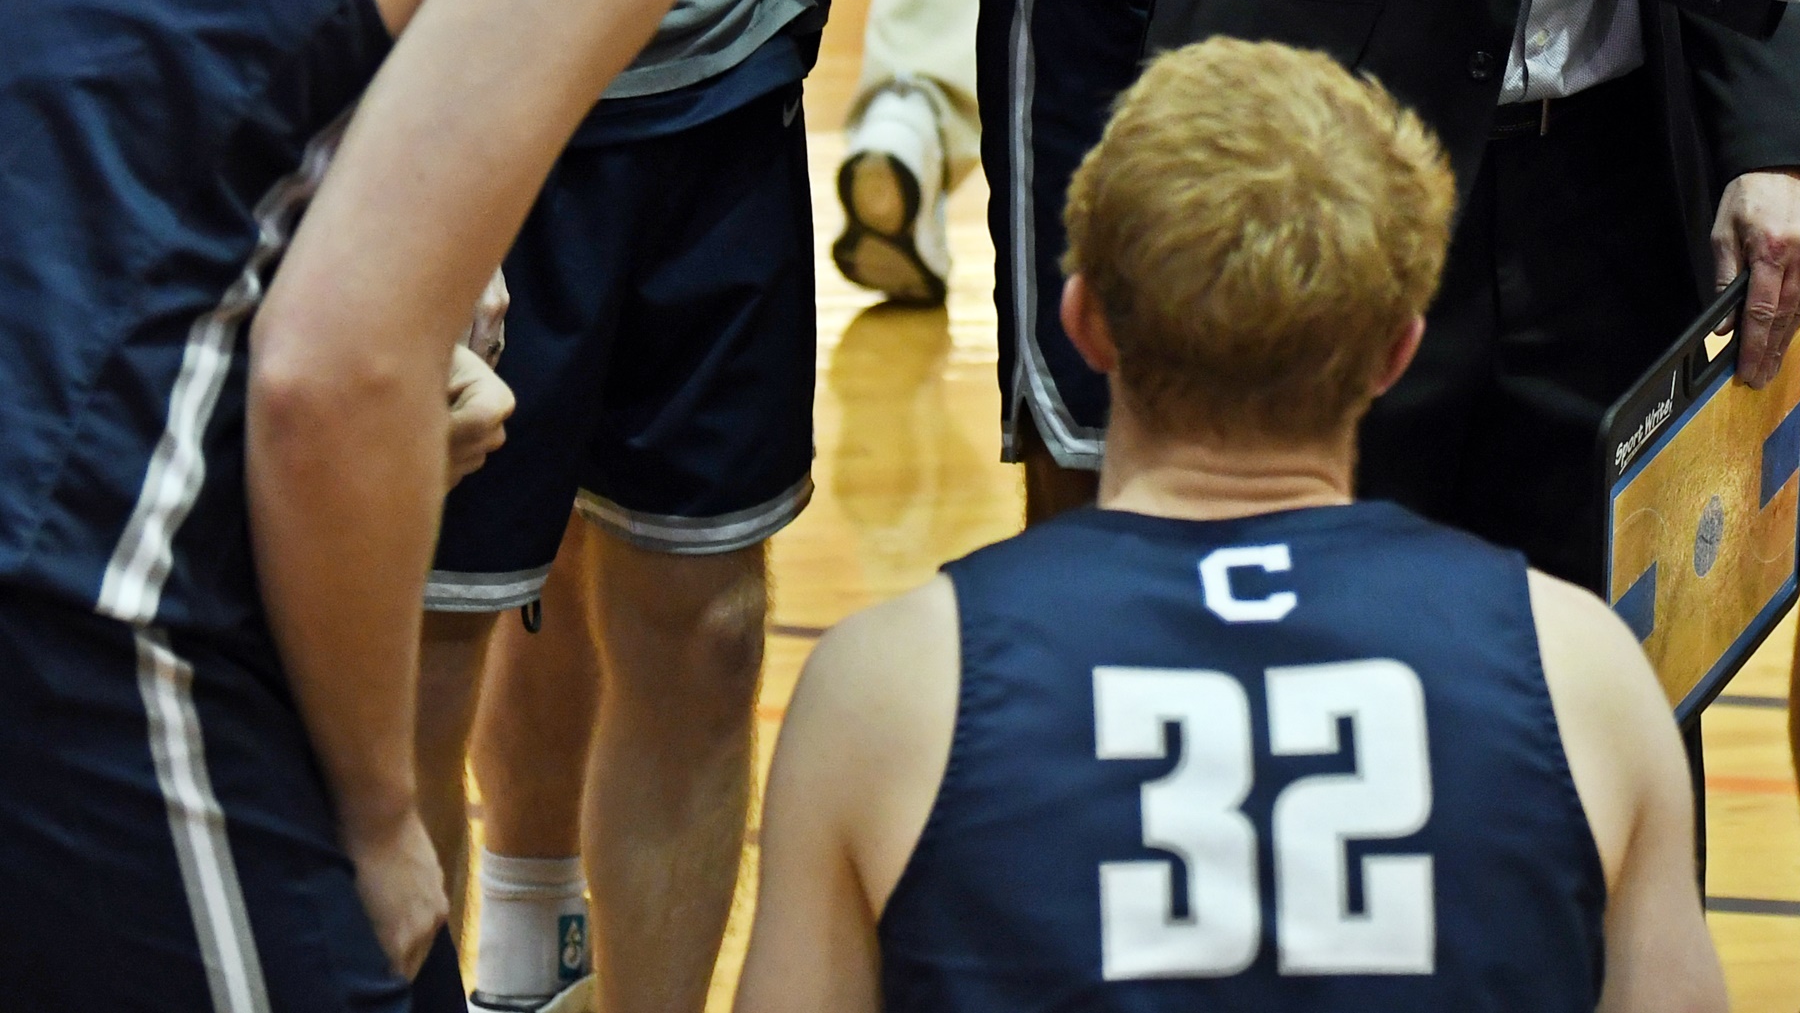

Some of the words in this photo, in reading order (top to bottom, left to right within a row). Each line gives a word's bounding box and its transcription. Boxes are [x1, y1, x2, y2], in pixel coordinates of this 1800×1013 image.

[1615, 424, 1643, 468] Sport
[1200, 543, 1297, 624] C
[1092, 658, 1437, 982] 32
